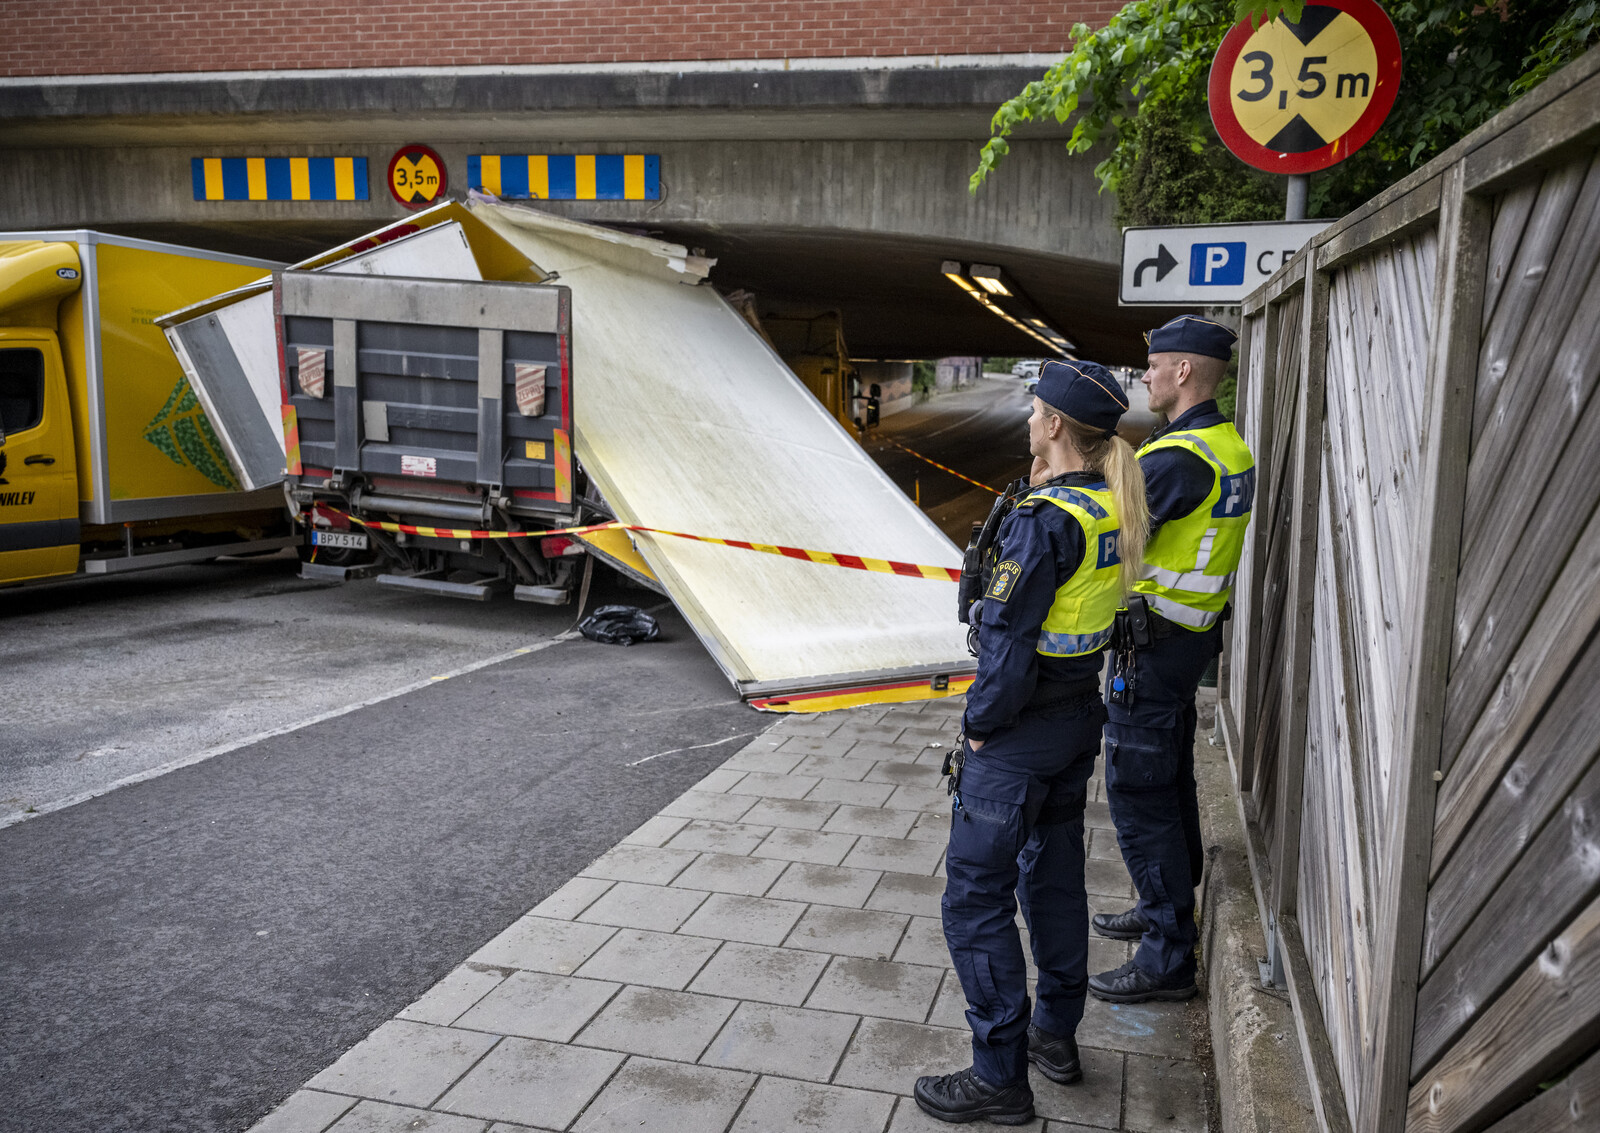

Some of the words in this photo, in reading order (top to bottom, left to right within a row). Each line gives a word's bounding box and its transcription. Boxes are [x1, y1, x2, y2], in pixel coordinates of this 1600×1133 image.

[1204, 246, 1230, 282] P
[321, 533, 340, 545] BPY
[343, 535, 363, 548] 514
[1000, 562, 1019, 575] POLIS
